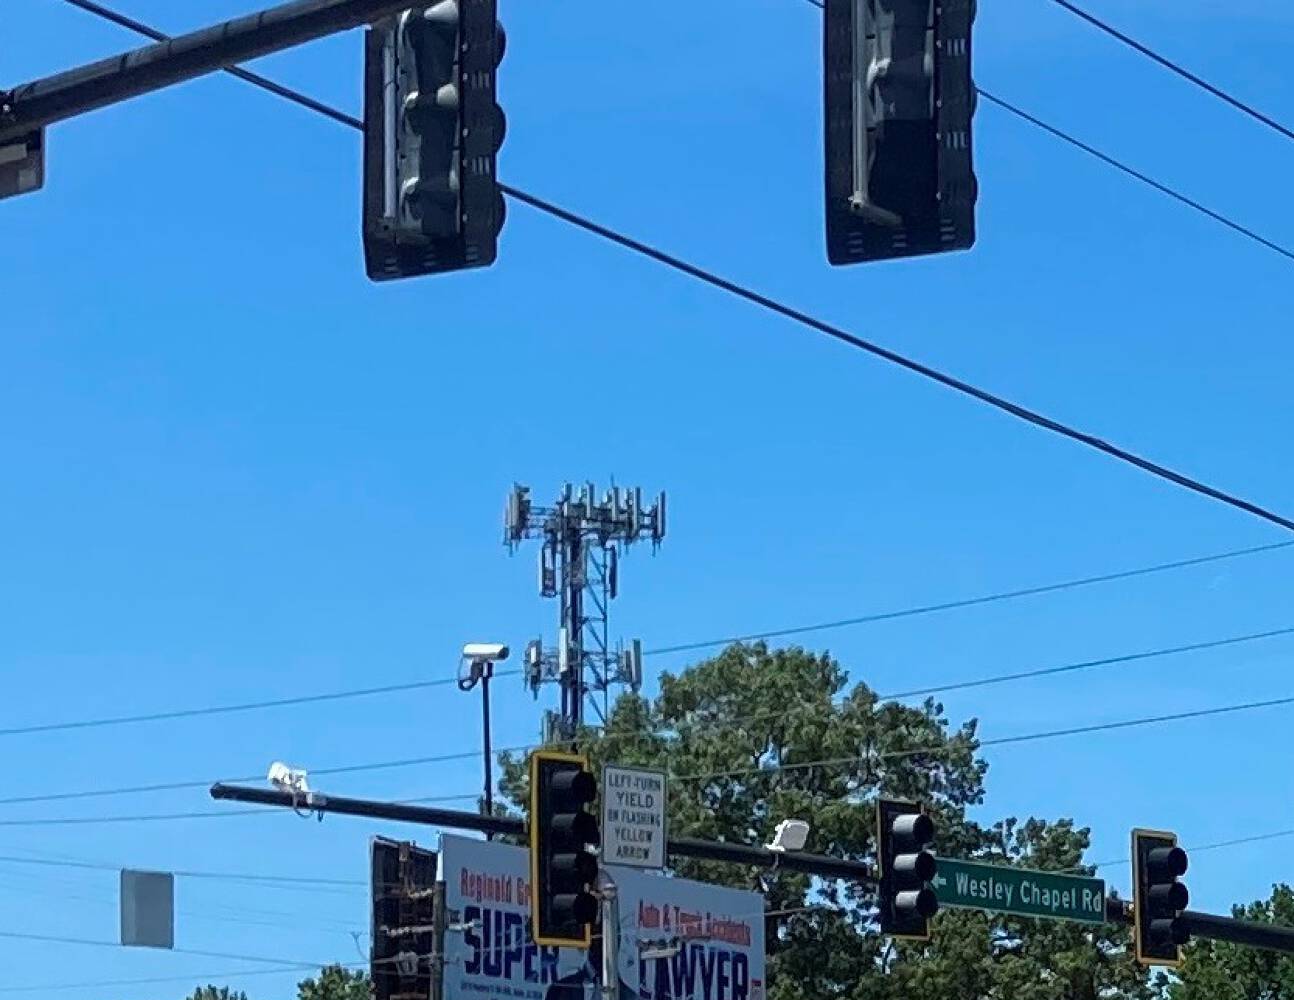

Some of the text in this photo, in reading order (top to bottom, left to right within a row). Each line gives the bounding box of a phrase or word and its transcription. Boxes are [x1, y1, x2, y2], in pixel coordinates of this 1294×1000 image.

[616, 791, 654, 808] YIELD
[615, 828, 653, 843] YELLOW
[616, 845, 650, 860] ARROW
[955, 871, 1102, 913] Wesley Chapel Rd
[463, 906, 560, 984] SUPER
